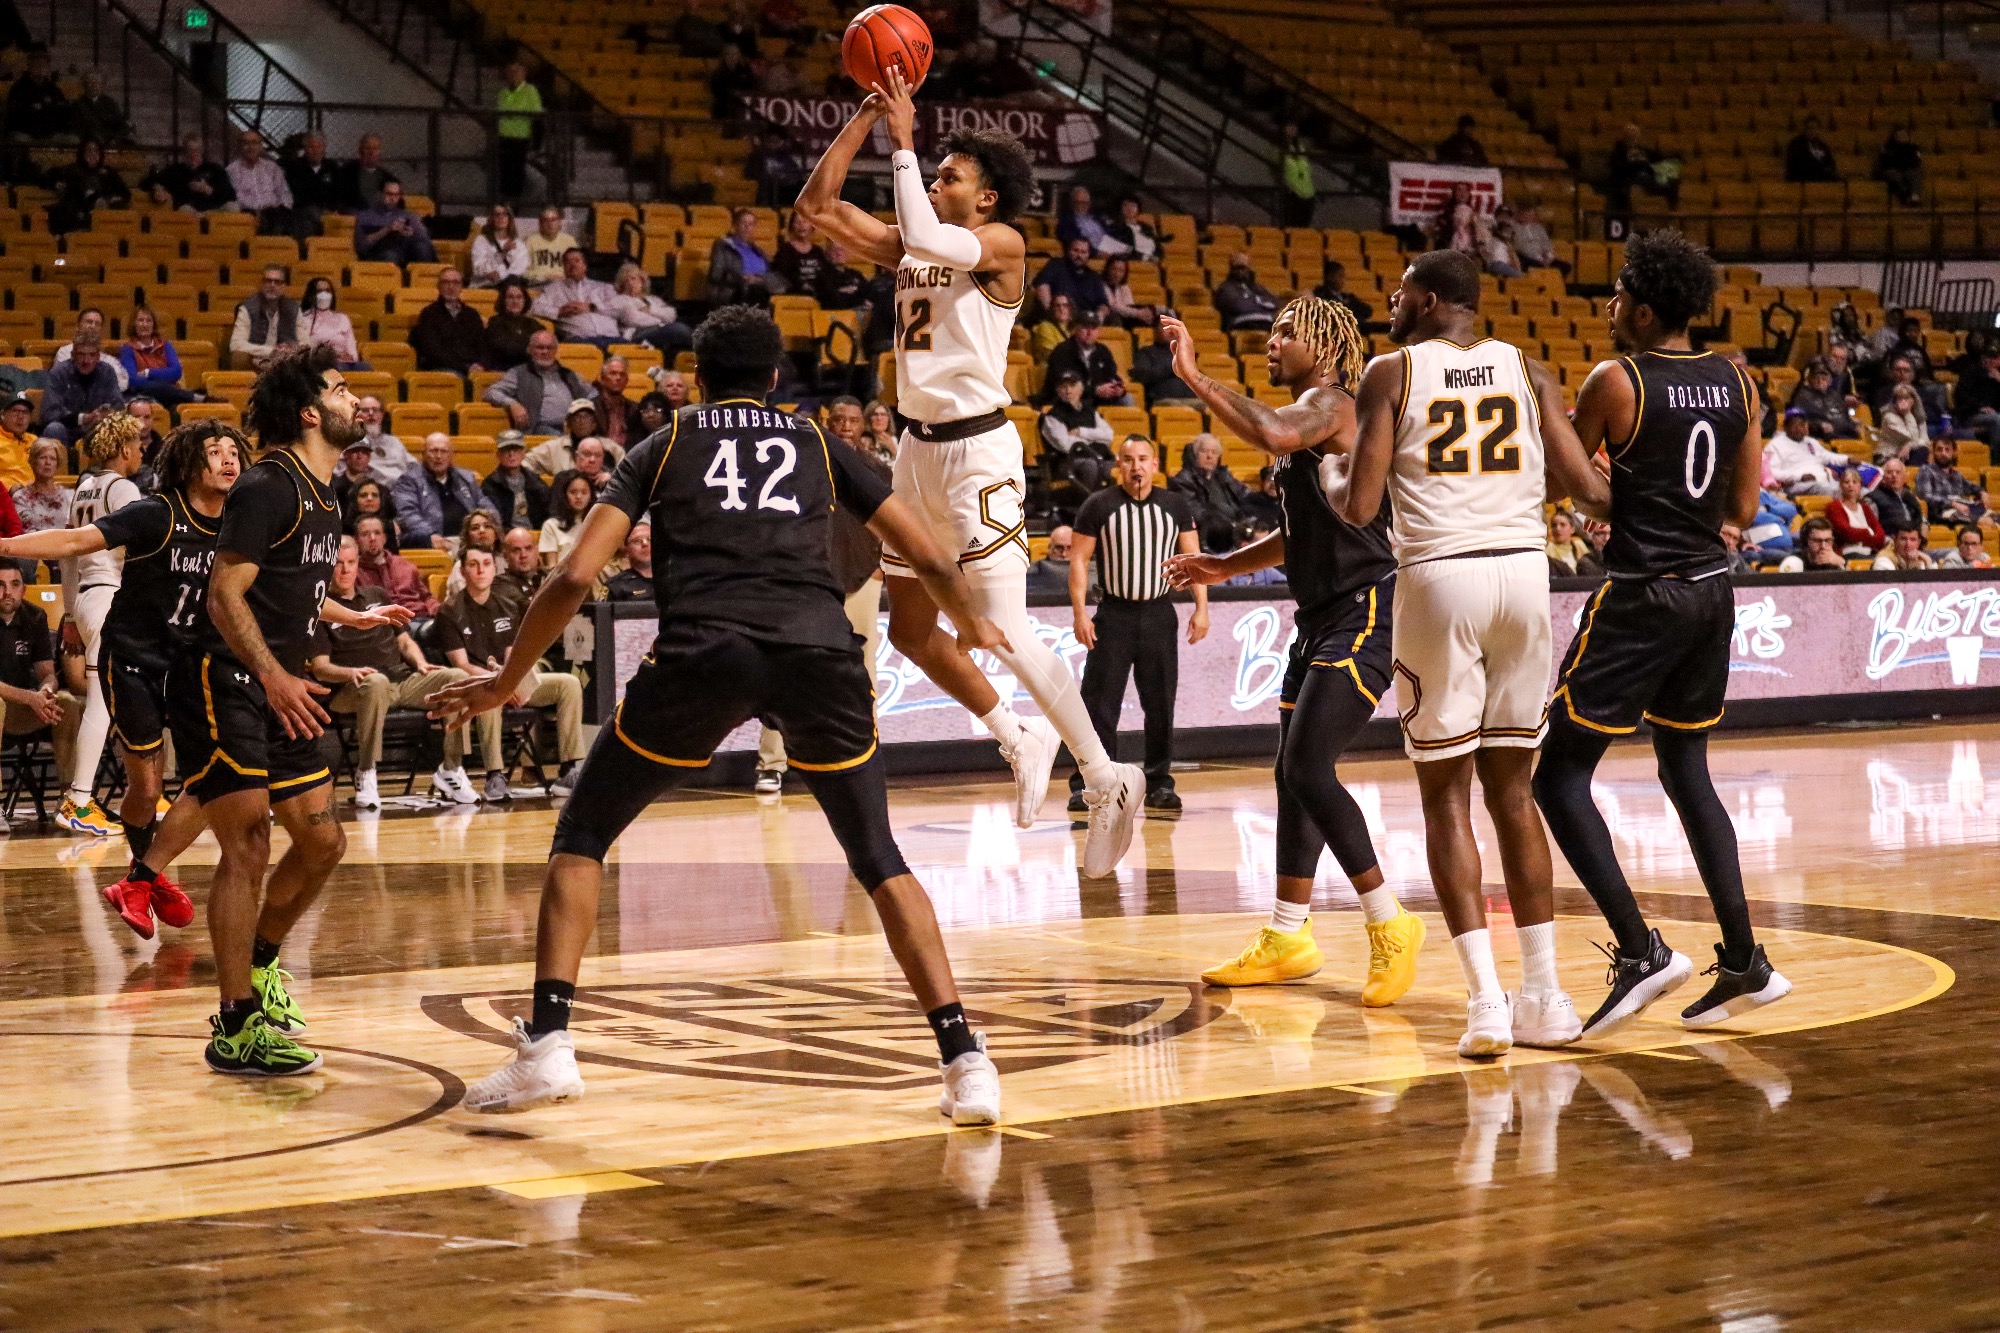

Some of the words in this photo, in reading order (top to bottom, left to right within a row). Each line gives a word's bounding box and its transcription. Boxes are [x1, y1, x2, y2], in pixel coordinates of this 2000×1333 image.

[935, 105, 1048, 139] HONOR
[895, 265, 954, 293] RONCOS
[1443, 365, 1495, 389] WRIGHT
[1667, 385, 1730, 408] ROLLINS
[697, 408, 797, 430] HORNBEAK
[1424, 393, 1521, 476] 22
[1685, 420, 1716, 499] 0
[703, 437, 801, 515] 42
[170, 547, 202, 575] Kent
[301, 533, 327, 564] Kent
